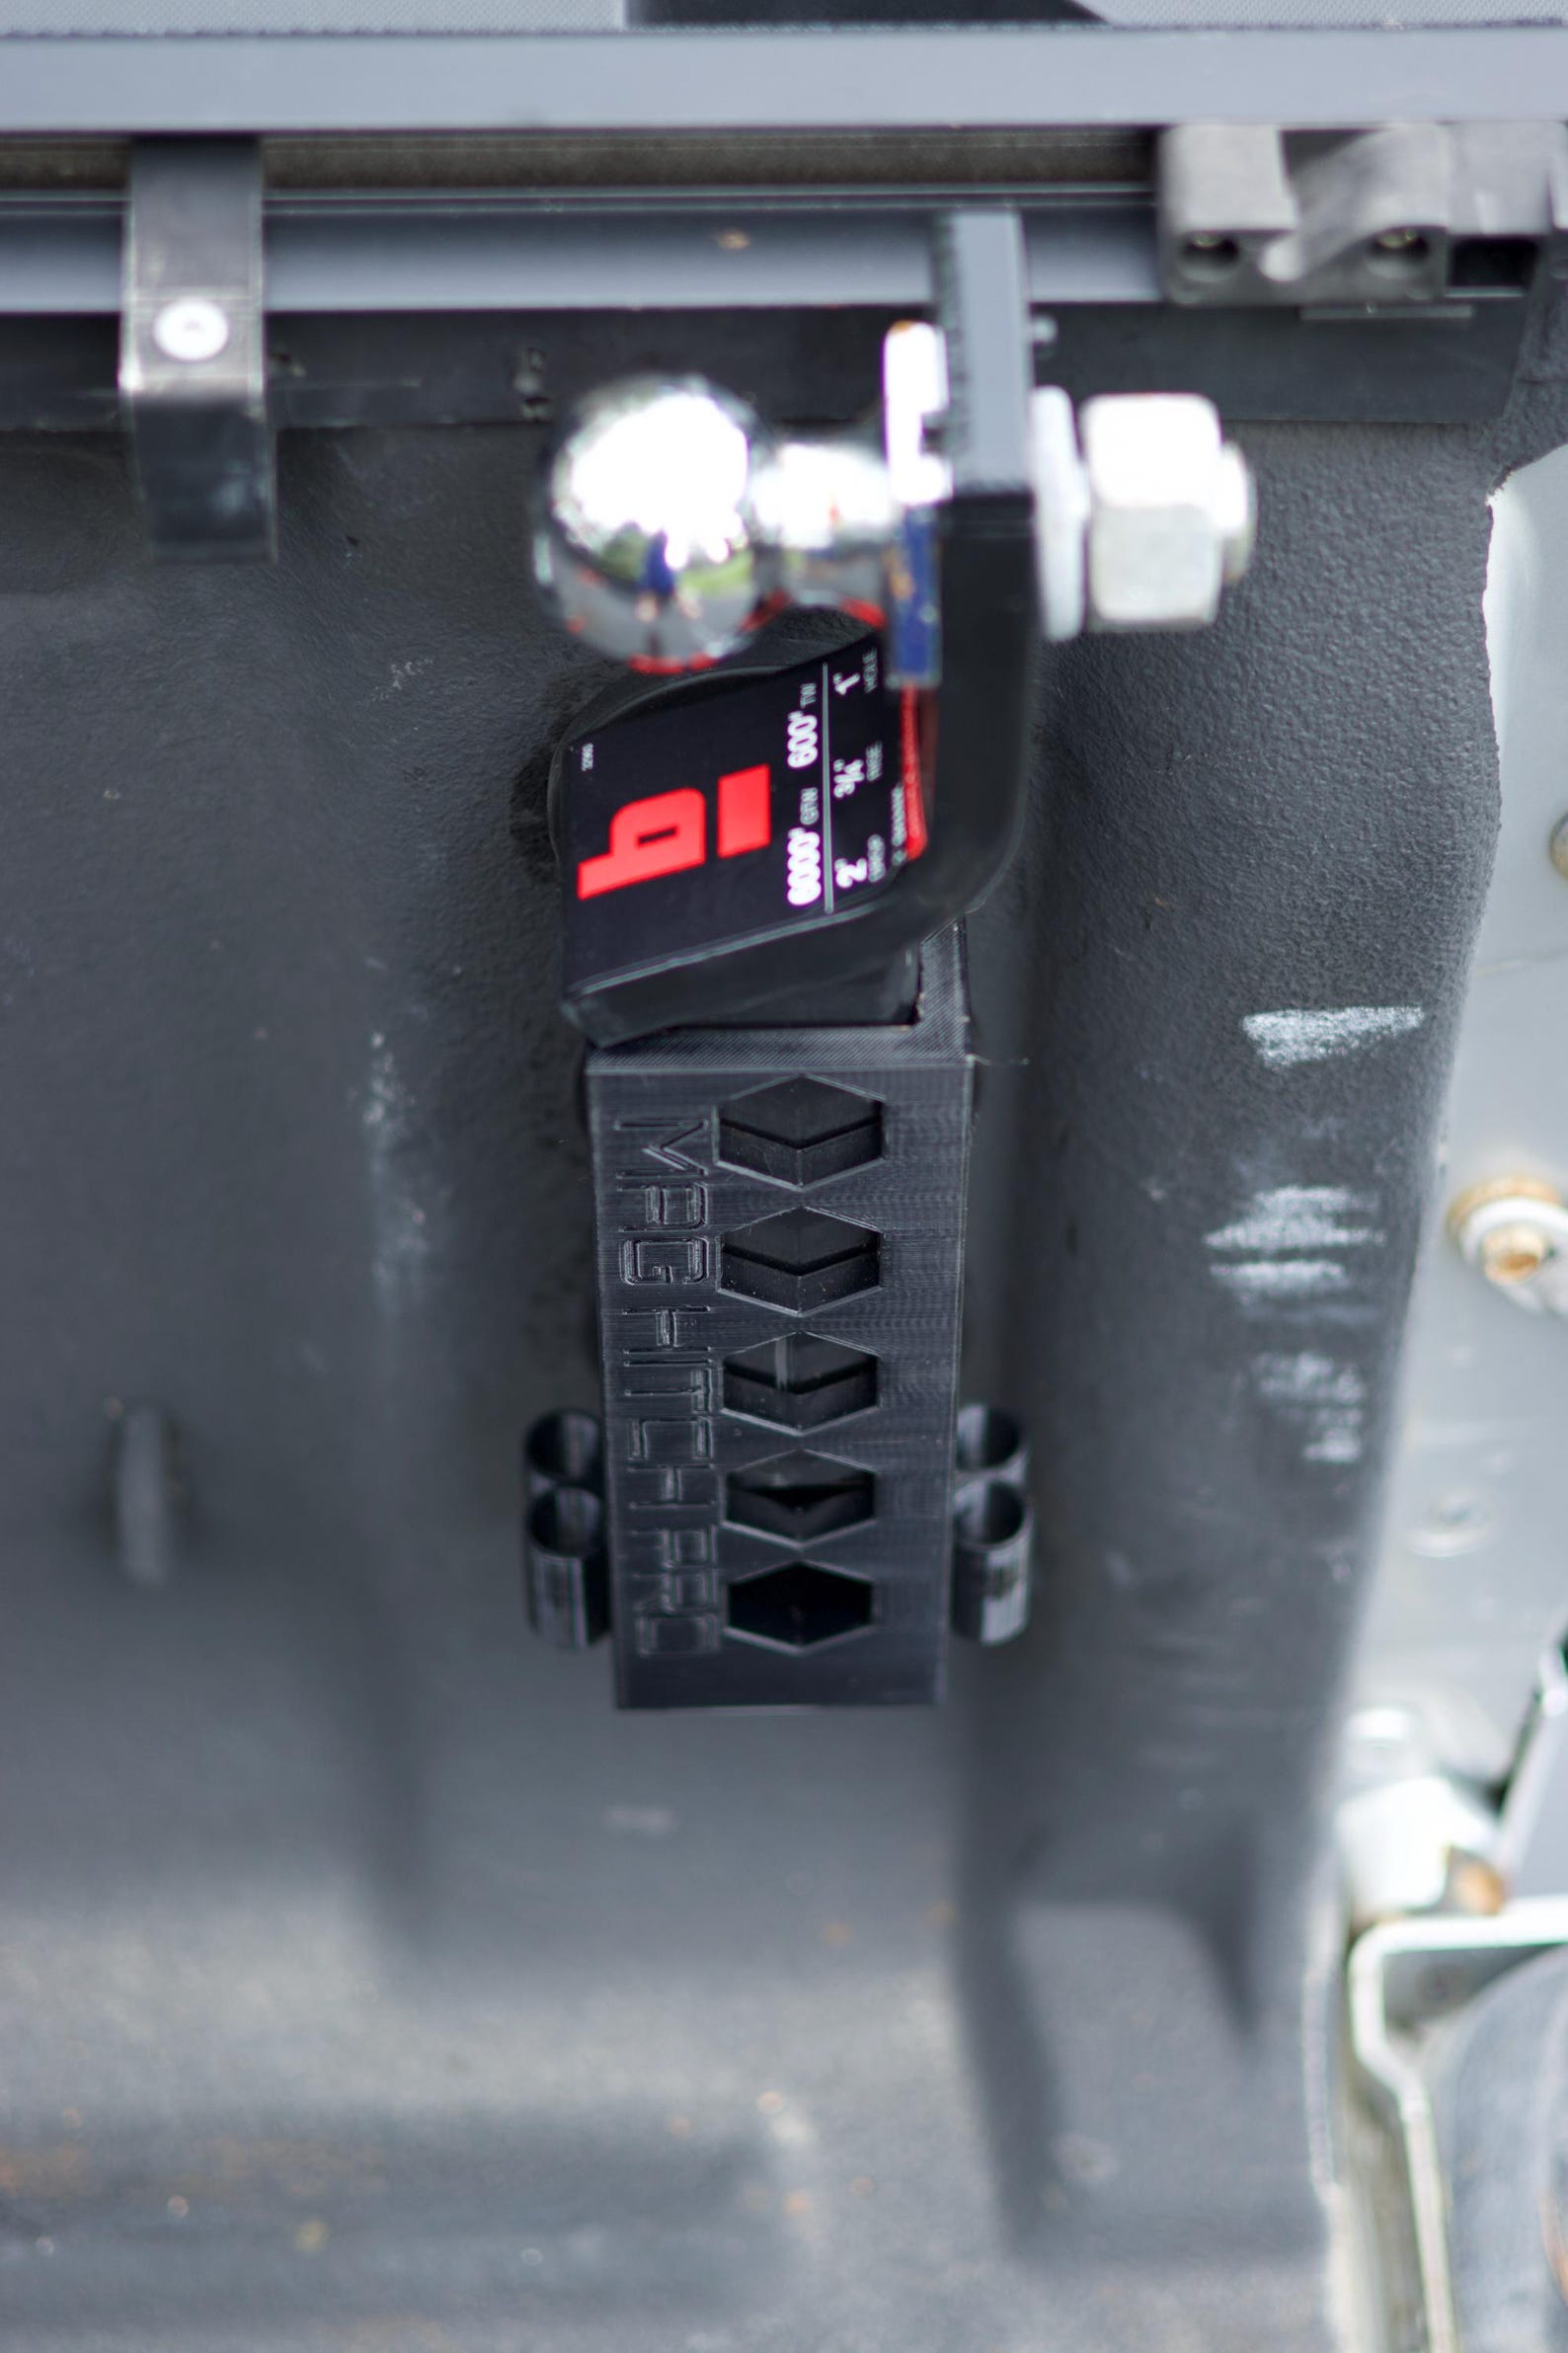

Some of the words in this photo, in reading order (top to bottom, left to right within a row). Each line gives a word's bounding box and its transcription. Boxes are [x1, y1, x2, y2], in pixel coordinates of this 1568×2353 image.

[832, 672, 861, 695] 1"
[862, 648, 879, 693] HOLE
[800, 682, 817, 708] TW
[865, 742, 884, 781] RISE
[800, 787, 819, 825] GTW
[613, 1118, 710, 1285] MAG
[621, 1304, 717, 1510] HITCH
[628, 1528, 722, 1659] PRO
